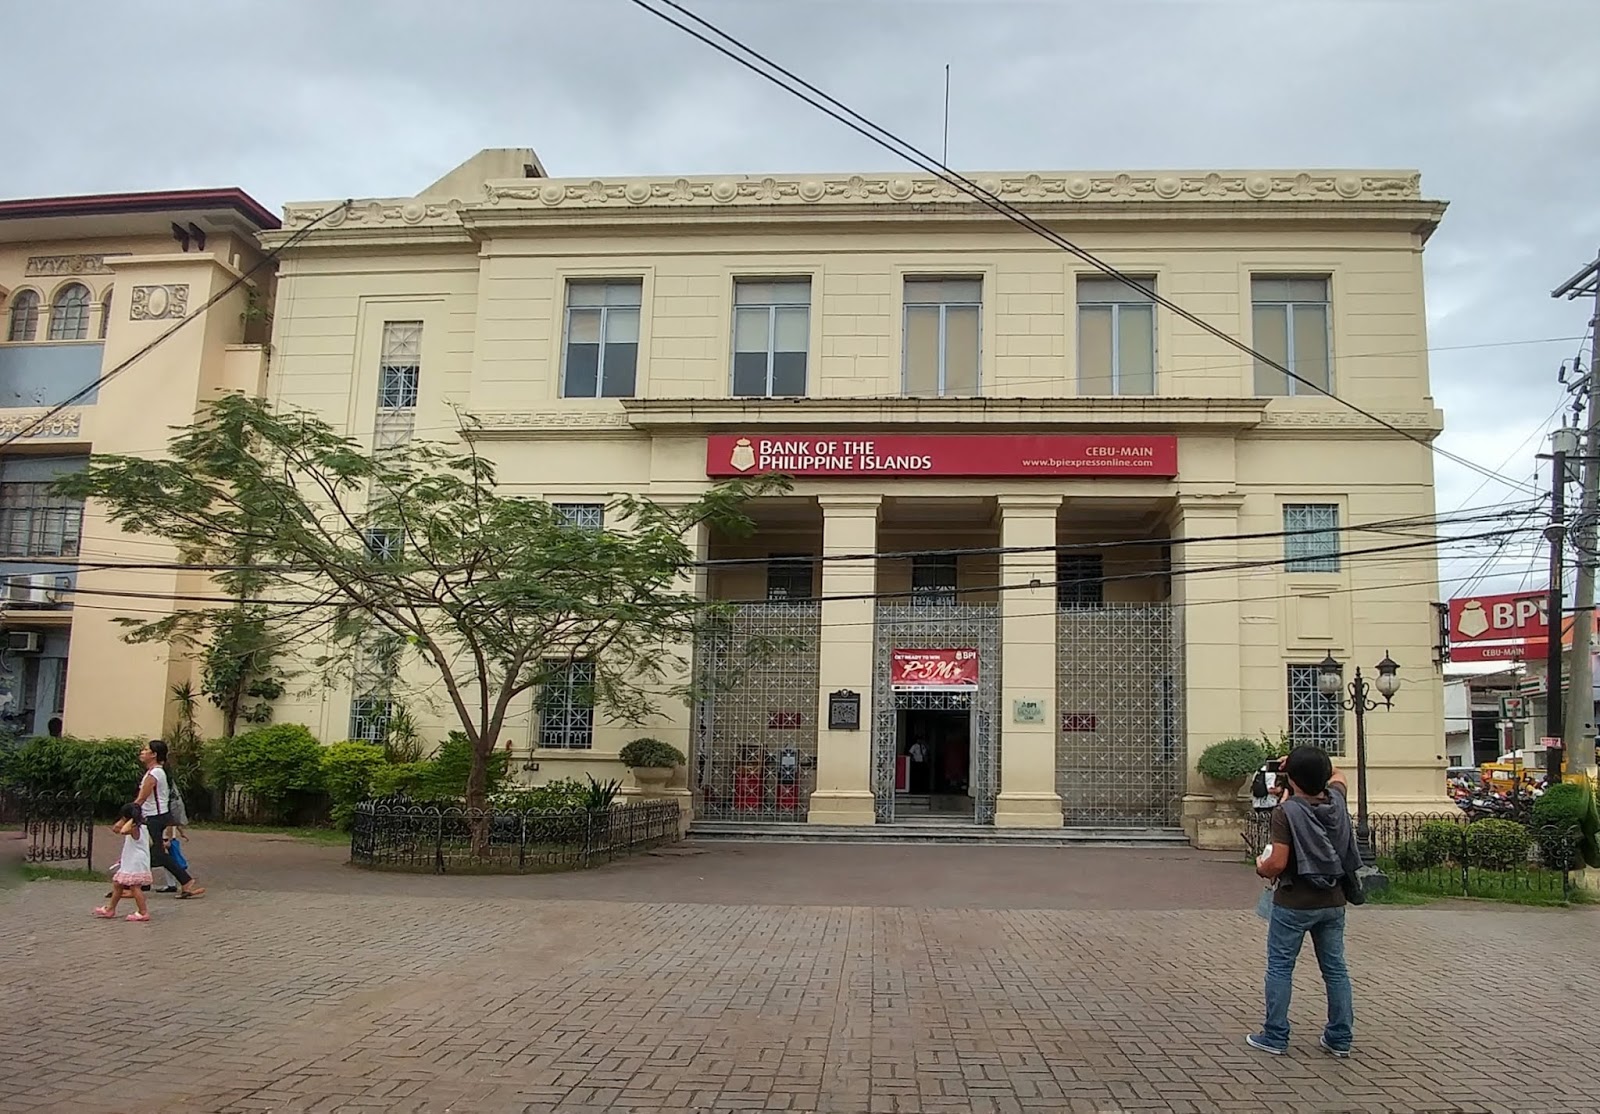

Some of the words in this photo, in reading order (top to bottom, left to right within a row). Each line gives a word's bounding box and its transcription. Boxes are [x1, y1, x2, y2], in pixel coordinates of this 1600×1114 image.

[759, 440, 809, 455] BANK
[815, 441, 837, 455] OF
[843, 441, 874, 455] THE
[1086, 447, 1153, 456] CEBU-MAIN
[759, 455, 853, 470] PHILIPPINE
[860, 455, 932, 470] ISLANDS
[1022, 458, 1153, 468] www.bpiexpressonline.com
[1493, 600, 1548, 629] BPI
[963, 651, 976, 659] BPI
[1482, 648, 1524, 657] CEBU-MAIN
